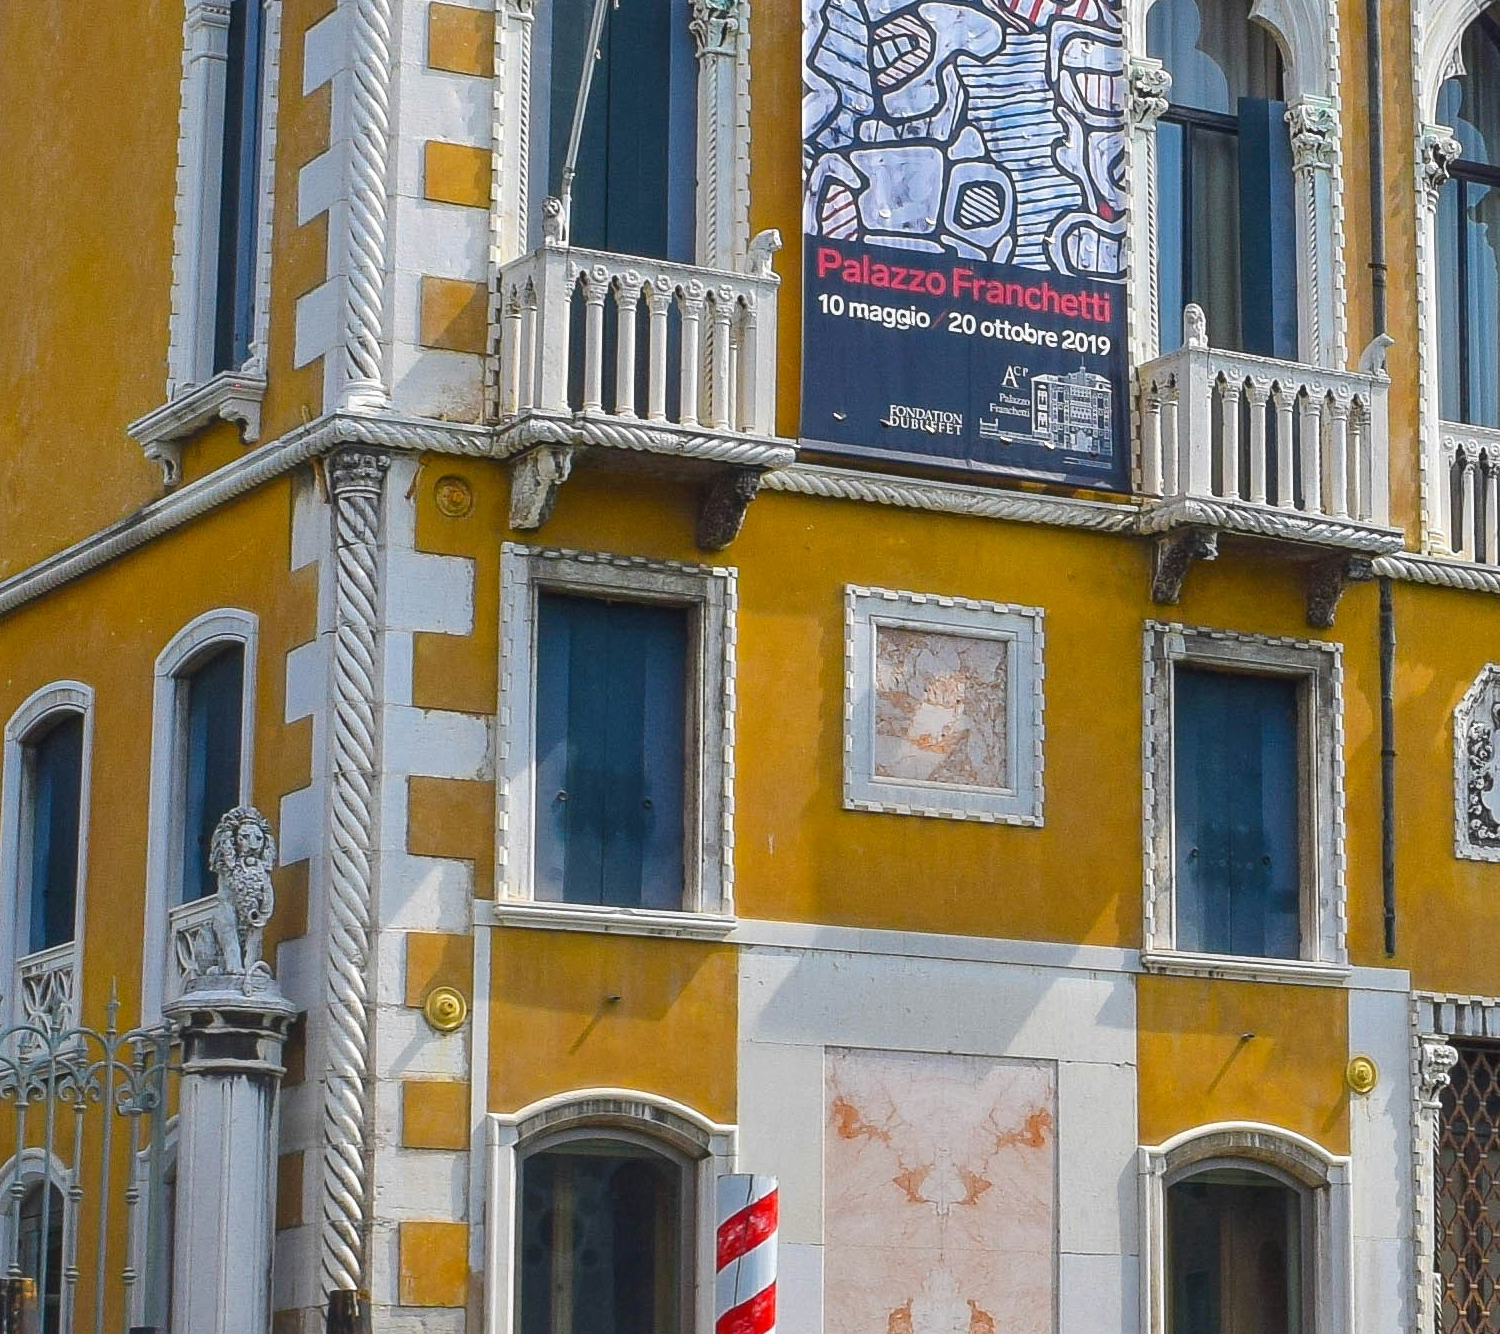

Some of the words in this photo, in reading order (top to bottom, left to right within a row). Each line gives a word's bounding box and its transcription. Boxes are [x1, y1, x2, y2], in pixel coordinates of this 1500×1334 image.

[817, 247, 947, 296] Palazzo
[952, 267, 1113, 323] Franchetti
[818, 293, 845, 316] 10
[848, 301, 931, 330] maggio
[948, 312, 977, 335] 20
[980, 319, 1059, 348] ottobre
[1062, 330, 1111, 356] 2019
[890, 405, 963, 424] FONDATION
